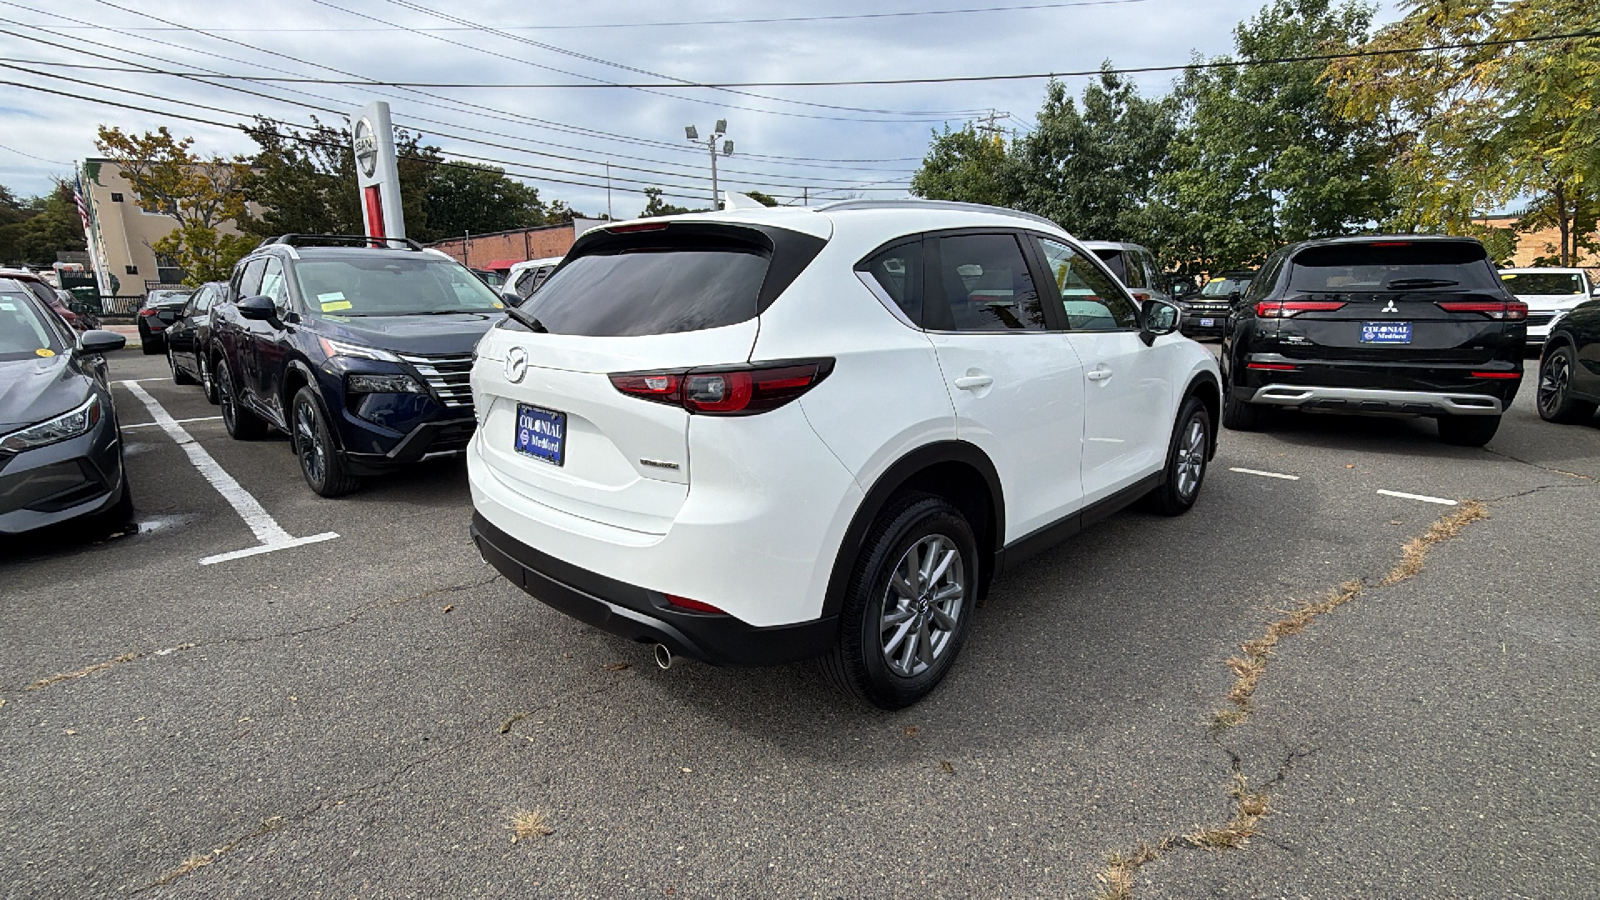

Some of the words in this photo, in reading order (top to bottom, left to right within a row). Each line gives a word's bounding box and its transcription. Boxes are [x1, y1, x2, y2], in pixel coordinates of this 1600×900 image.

[1362, 326, 1409, 334] COLONIAL
[519, 414, 562, 439] COLONIAL
[531, 434, 559, 453] Medford
